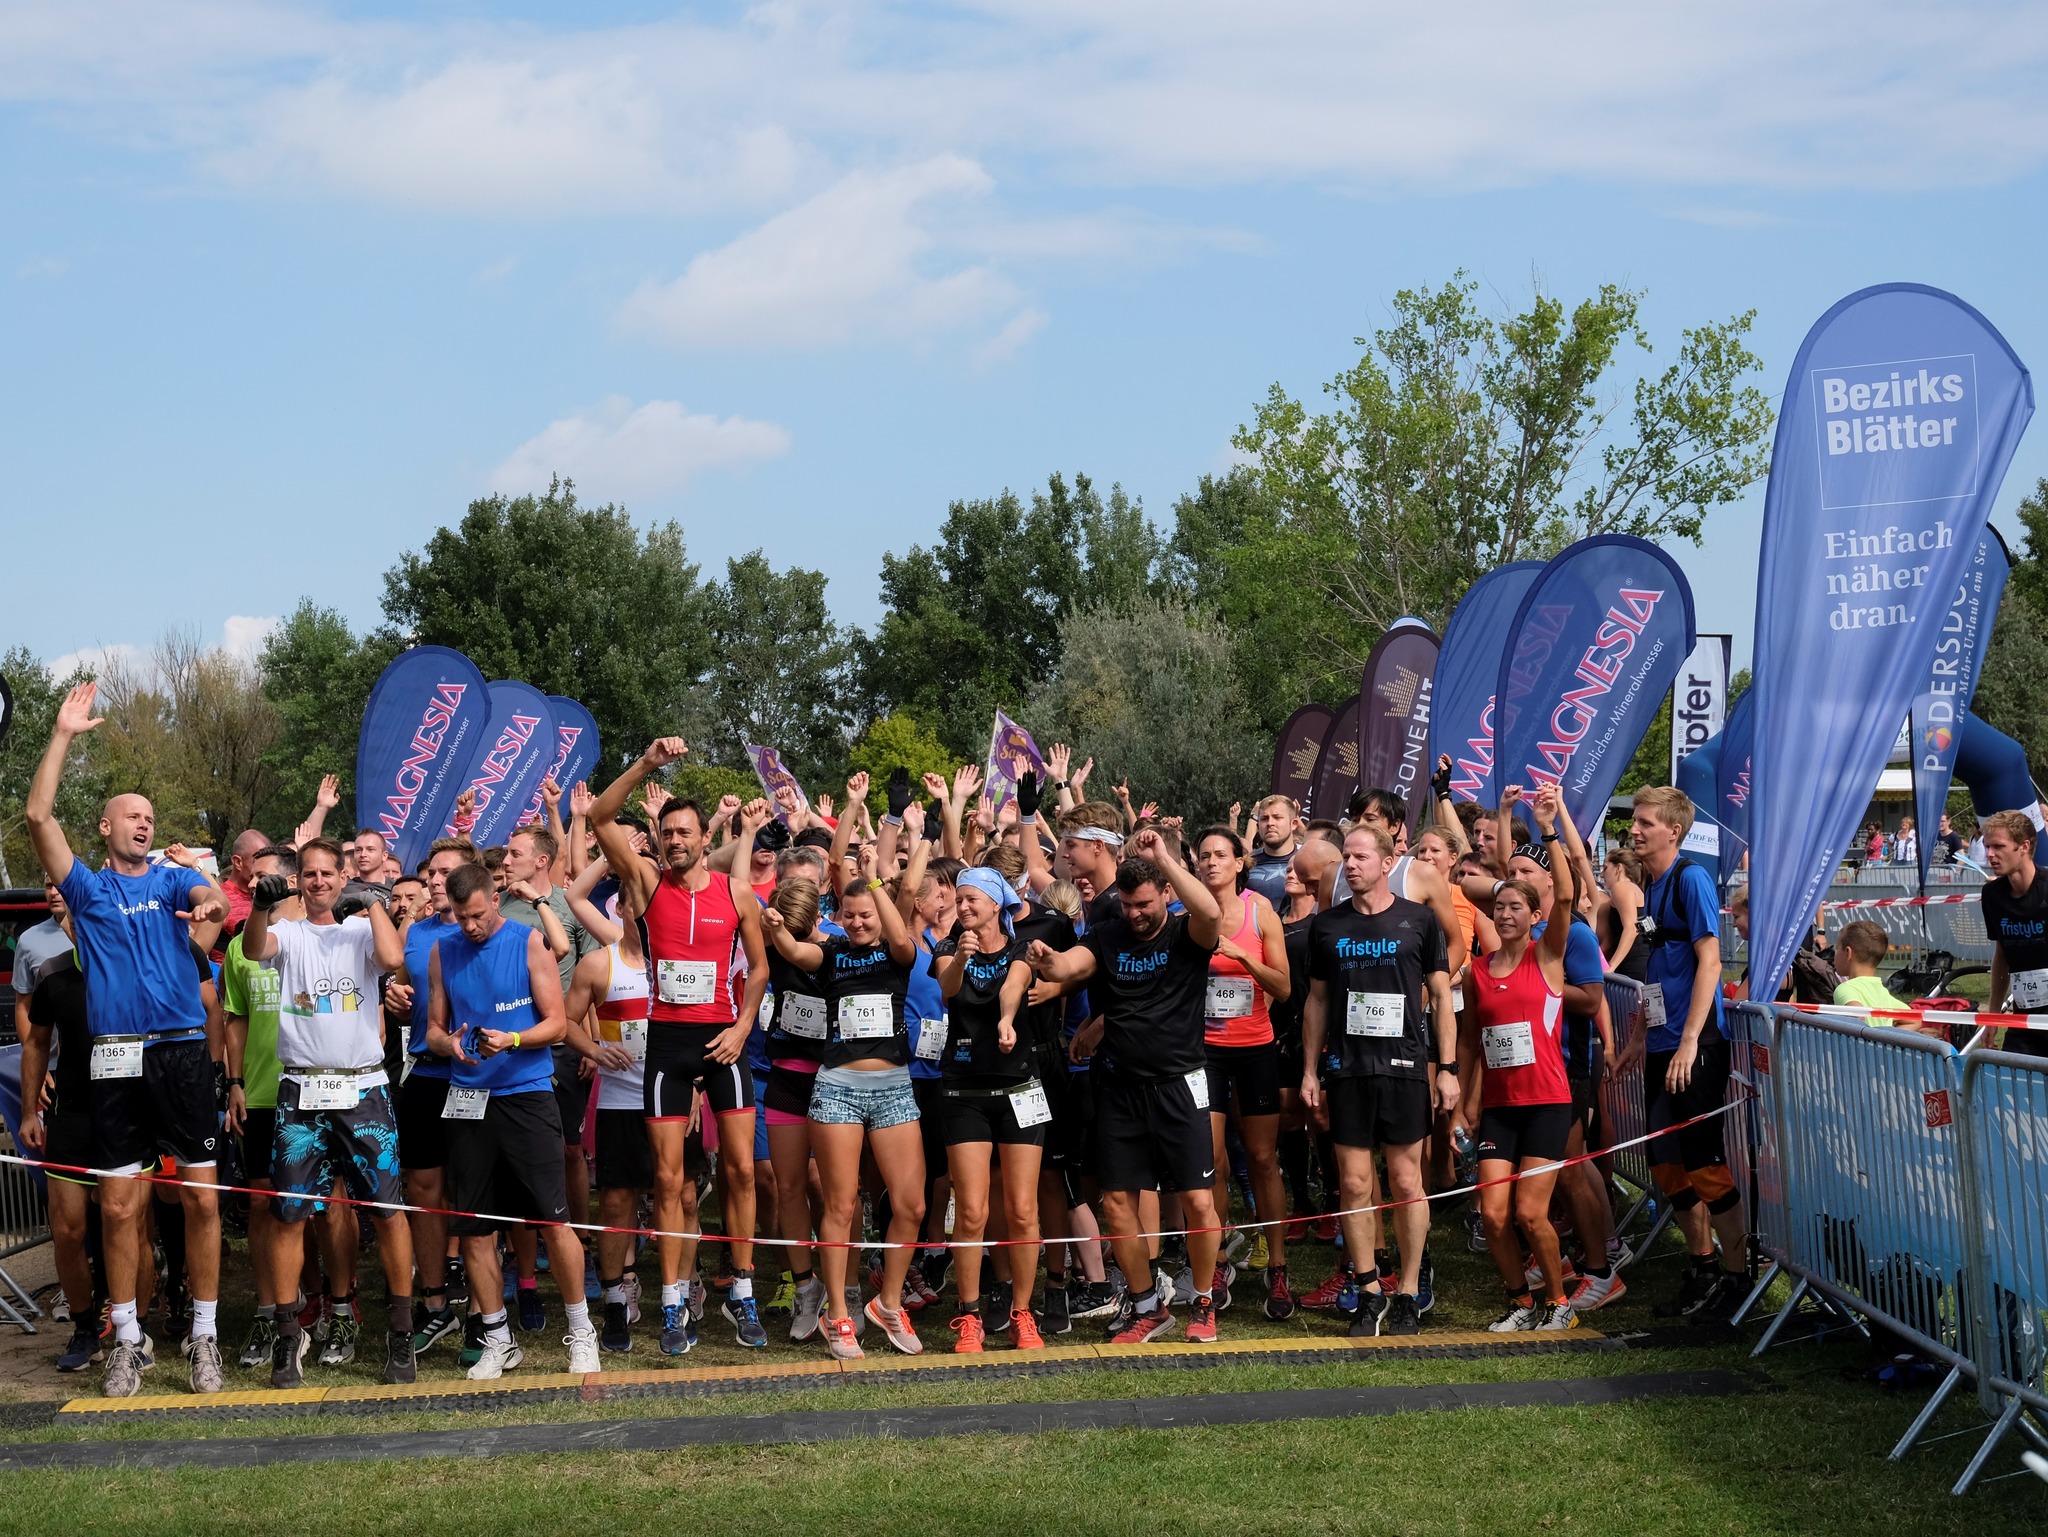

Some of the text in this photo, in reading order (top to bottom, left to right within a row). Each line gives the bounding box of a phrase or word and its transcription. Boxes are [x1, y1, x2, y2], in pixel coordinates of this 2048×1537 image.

[1823, 368, 1964, 413] Bezirks
[1826, 415, 1957, 455] Blätter
[1824, 521, 1953, 560] Einfach
[1826, 563, 1930, 596] näher
[1973, 571, 1983, 593] am
[1829, 602, 1917, 632] dran.
[1519, 588, 1665, 811] MAGNESIA
[1571, 637, 1665, 795] Natürliches Mineralwasser
[1677, 673, 1712, 772] ipfer
[1394, 677, 1433, 801] RONEHIT
[378, 683, 468, 851] MAGNESIA
[413, 716, 470, 833] Natürliches Mineralwasser
[445, 714, 542, 839] GNESIA
[561, 754, 583, 793] eralwasser
[476, 747, 540, 846] Natürliches Mineralwasser
[2000, 918, 2044, 938] Tristyle
[1335, 937, 1397, 958] Tristyle
[836, 951, 887, 968] Tristyle
[1117, 951, 1168, 972] Tristyle
[1340, 957, 1397, 971] push your limit
[675, 973, 696, 984] 469
[856, 966, 872, 975] your
[1216, 989, 1235, 999] 468
[2022, 982, 2038, 991] 764
[495, 997, 533, 1013] Markus
[795, 1006, 813, 1018] 760
[856, 1008, 875, 1018] 761
[1365, 1006, 1385, 1016] 766
[100, 1047, 126, 1057] 1365
[1495, 1037, 1513, 1048] 365
[316, 1080, 342, 1090] 1366
[455, 1089, 476, 1099] 1362
[1029, 1092, 1045, 1104] 770
